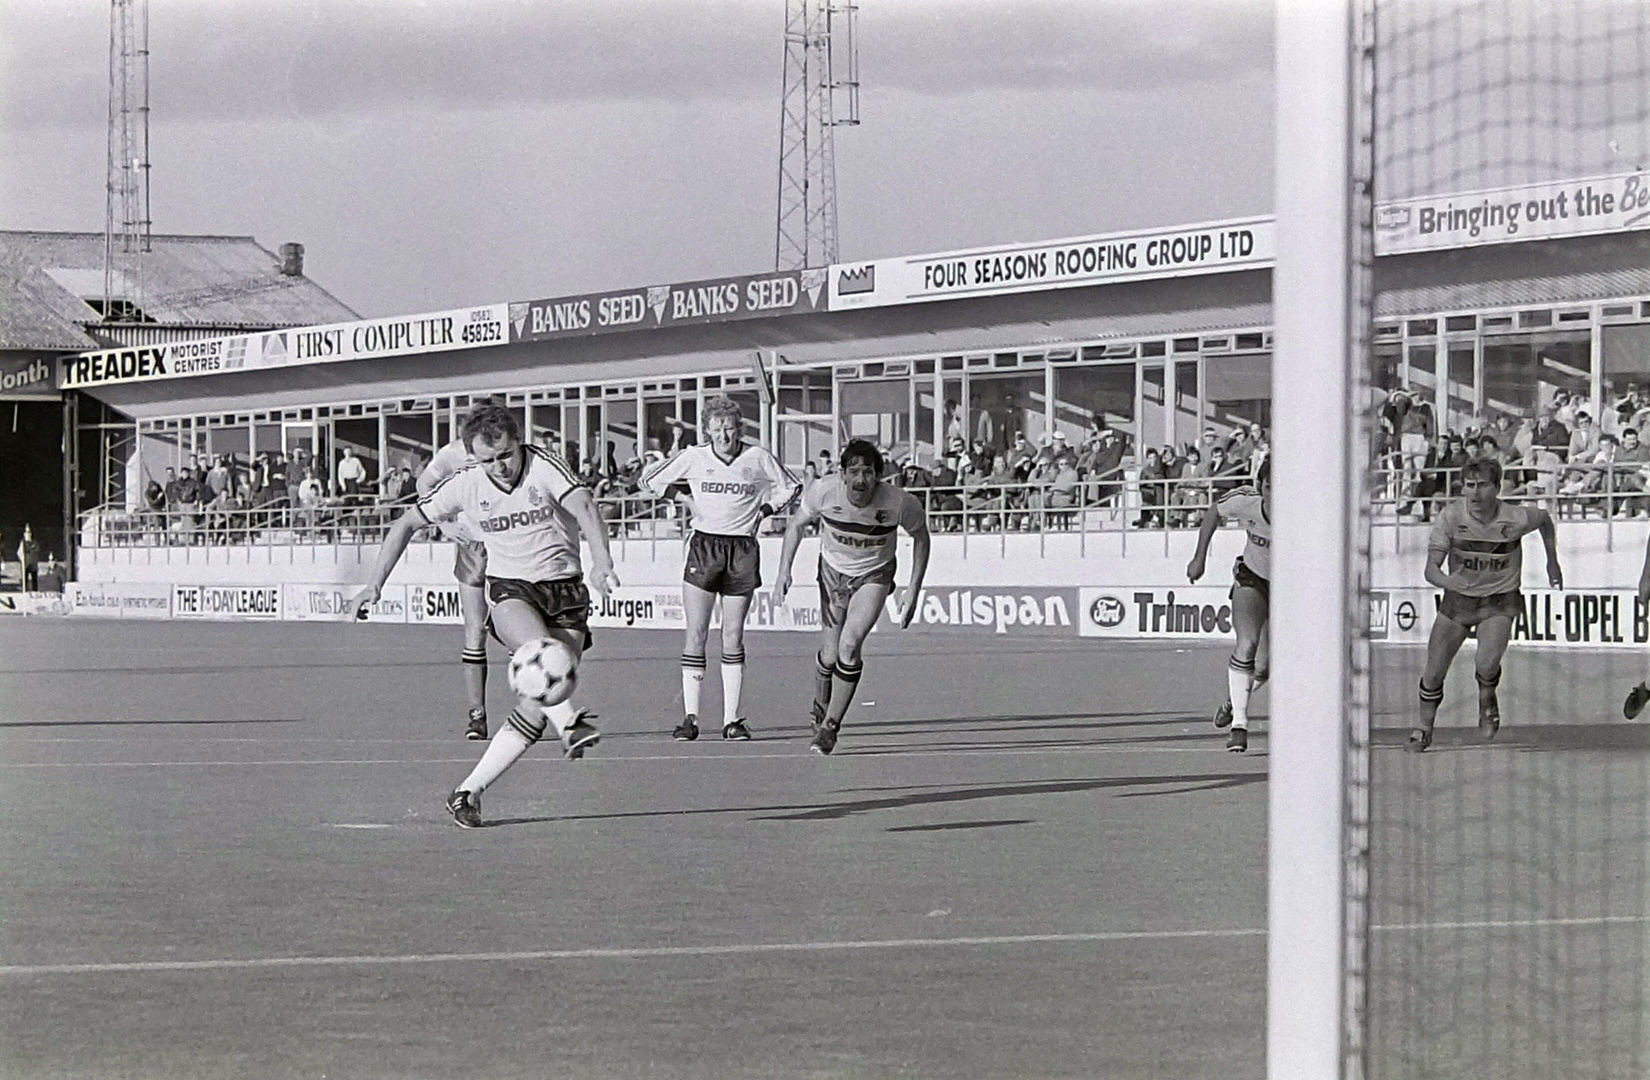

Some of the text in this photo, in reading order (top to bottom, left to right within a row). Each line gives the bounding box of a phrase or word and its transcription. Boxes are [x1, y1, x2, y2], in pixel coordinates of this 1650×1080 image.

[1419, 175, 1650, 237] Bringing out the Be
[924, 230, 1254, 290] FOUR SEASONS ROOFING GROUP LTD
[672, 277, 798, 319] BANKS SEED
[531, 294, 645, 334] BANKS SEED
[295, 317, 454, 360] FIRST COMPUTER
[461, 320, 502, 344] 458252
[170, 341, 223, 359] MOTORIST
[62, 346, 167, 384] TREADEX
[174, 356, 221, 374] CENTRES
[701, 481, 756, 496] BEDFORD
[479, 505, 554, 533] BEDFORD
[177, 589, 198, 612] THE
[236, 589, 278, 613] LEAGUE
[426, 590, 464, 617] SAM
[886, 590, 1071, 633] Wallspan
[1093, 598, 1121, 623] Ford
[1133, 591, 1233, 634] Trimoc
[792, 607, 821, 626] WELC
